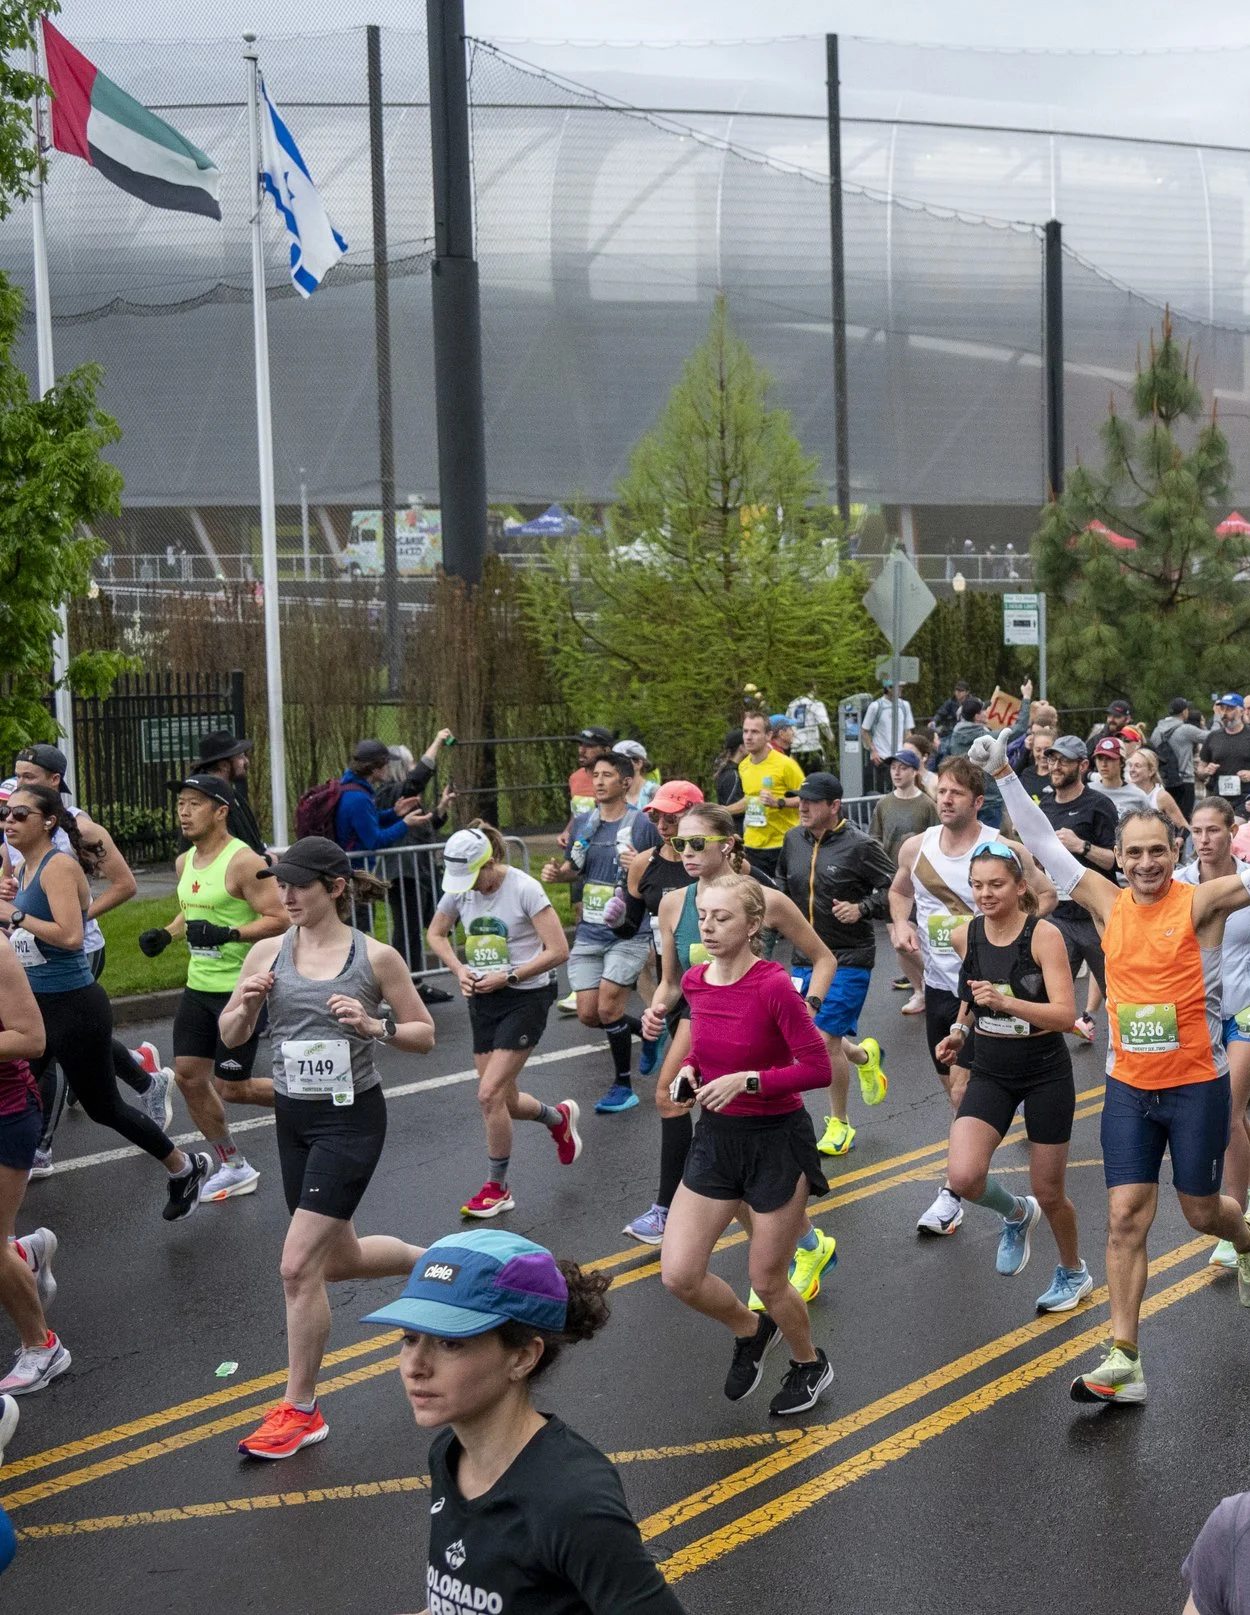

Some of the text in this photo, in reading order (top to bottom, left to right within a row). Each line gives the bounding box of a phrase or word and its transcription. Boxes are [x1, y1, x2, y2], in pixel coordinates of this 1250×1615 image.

[937, 928, 952, 942] 32
[474, 949, 499, 962] 3526
[1130, 1021, 1164, 1038] 3236
[297, 1060, 334, 1077] 7149
[427, 1565, 503, 1615] OLORADO
